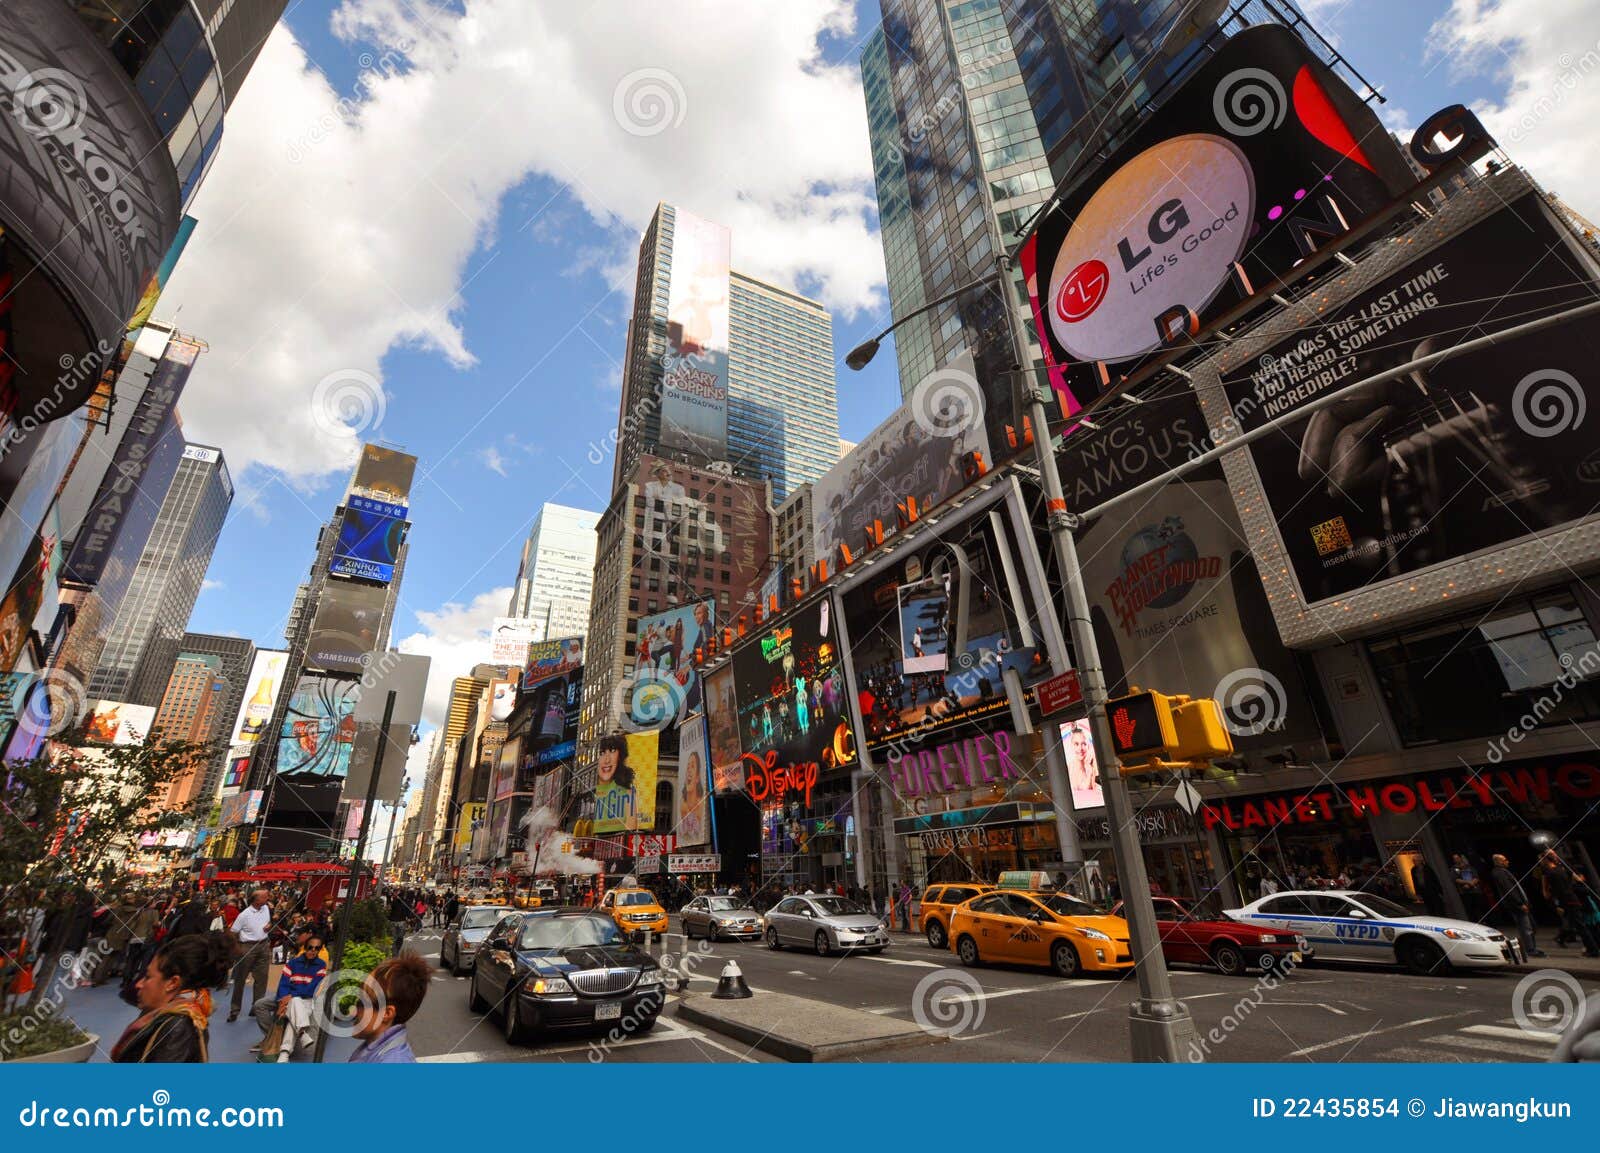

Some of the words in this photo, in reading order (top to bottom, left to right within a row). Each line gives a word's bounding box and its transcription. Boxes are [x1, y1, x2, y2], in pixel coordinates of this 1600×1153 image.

[1117, 199, 1190, 273] LG
[1130, 254, 1178, 295] Life's
[1182, 202, 1239, 253] Good
[1327, 315, 1359, 340] THE
[1360, 291, 1400, 322] LAST
[1401, 263, 1449, 296] TIME
[1255, 372, 1287, 403] YOU
[1289, 349, 1338, 384] HEARD
[1341, 292, 1439, 355] SOMETHING
[667, 372, 726, 400] POPPINS
[677, 365, 718, 387] MARY
[1262, 355, 1359, 418] INCREDIBLE?
[667, 391, 680, 399] ON
[682, 395, 723, 411] BROADWAY
[85, 444, 147, 551] SQUARE
[335, 564, 357, 575] NEWS
[358, 567, 388, 580] AGENCY
[345, 560, 380, 573] XINHUA
[1104, 544, 1170, 616] PLANET
[1119, 555, 1223, 637] HOLLYWOOD
[1136, 622, 1166, 640] TIMES
[1168, 603, 1219, 630] SQUARE
[318, 652, 364, 665] SAMSUNG
[888, 730, 1018, 799] FOREVER
[608, 784, 636, 819] Girl
[1203, 792, 1334, 832] PLANET
[919, 829, 971, 849] FOREVER
[1336, 923, 1380, 939] NYPD
